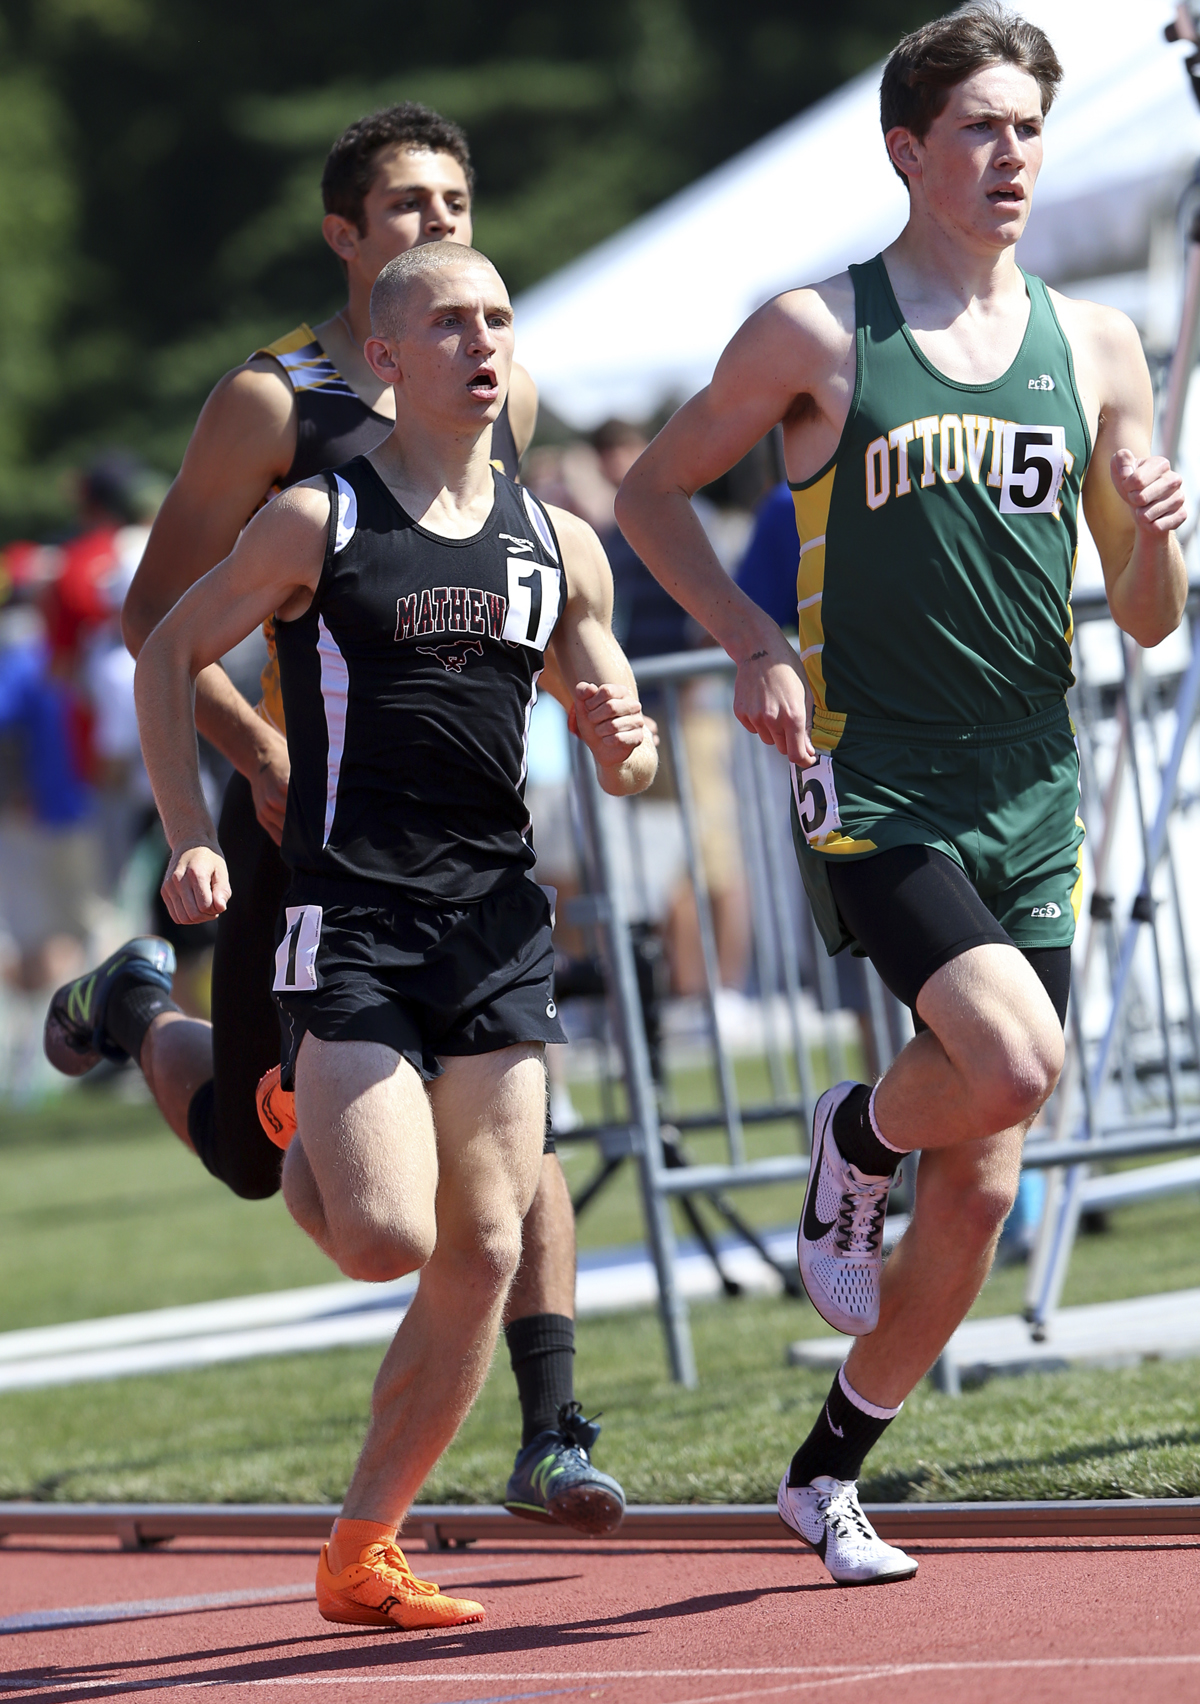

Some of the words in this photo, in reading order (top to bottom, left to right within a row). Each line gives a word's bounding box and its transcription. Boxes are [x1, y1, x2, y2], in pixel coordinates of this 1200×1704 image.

[865, 413, 1076, 522] OTTOVI
[1009, 432, 1054, 508] 5
[394, 587, 520, 649] MATHEW
[518, 569, 543, 643] 1
[795, 757, 828, 833] 5
